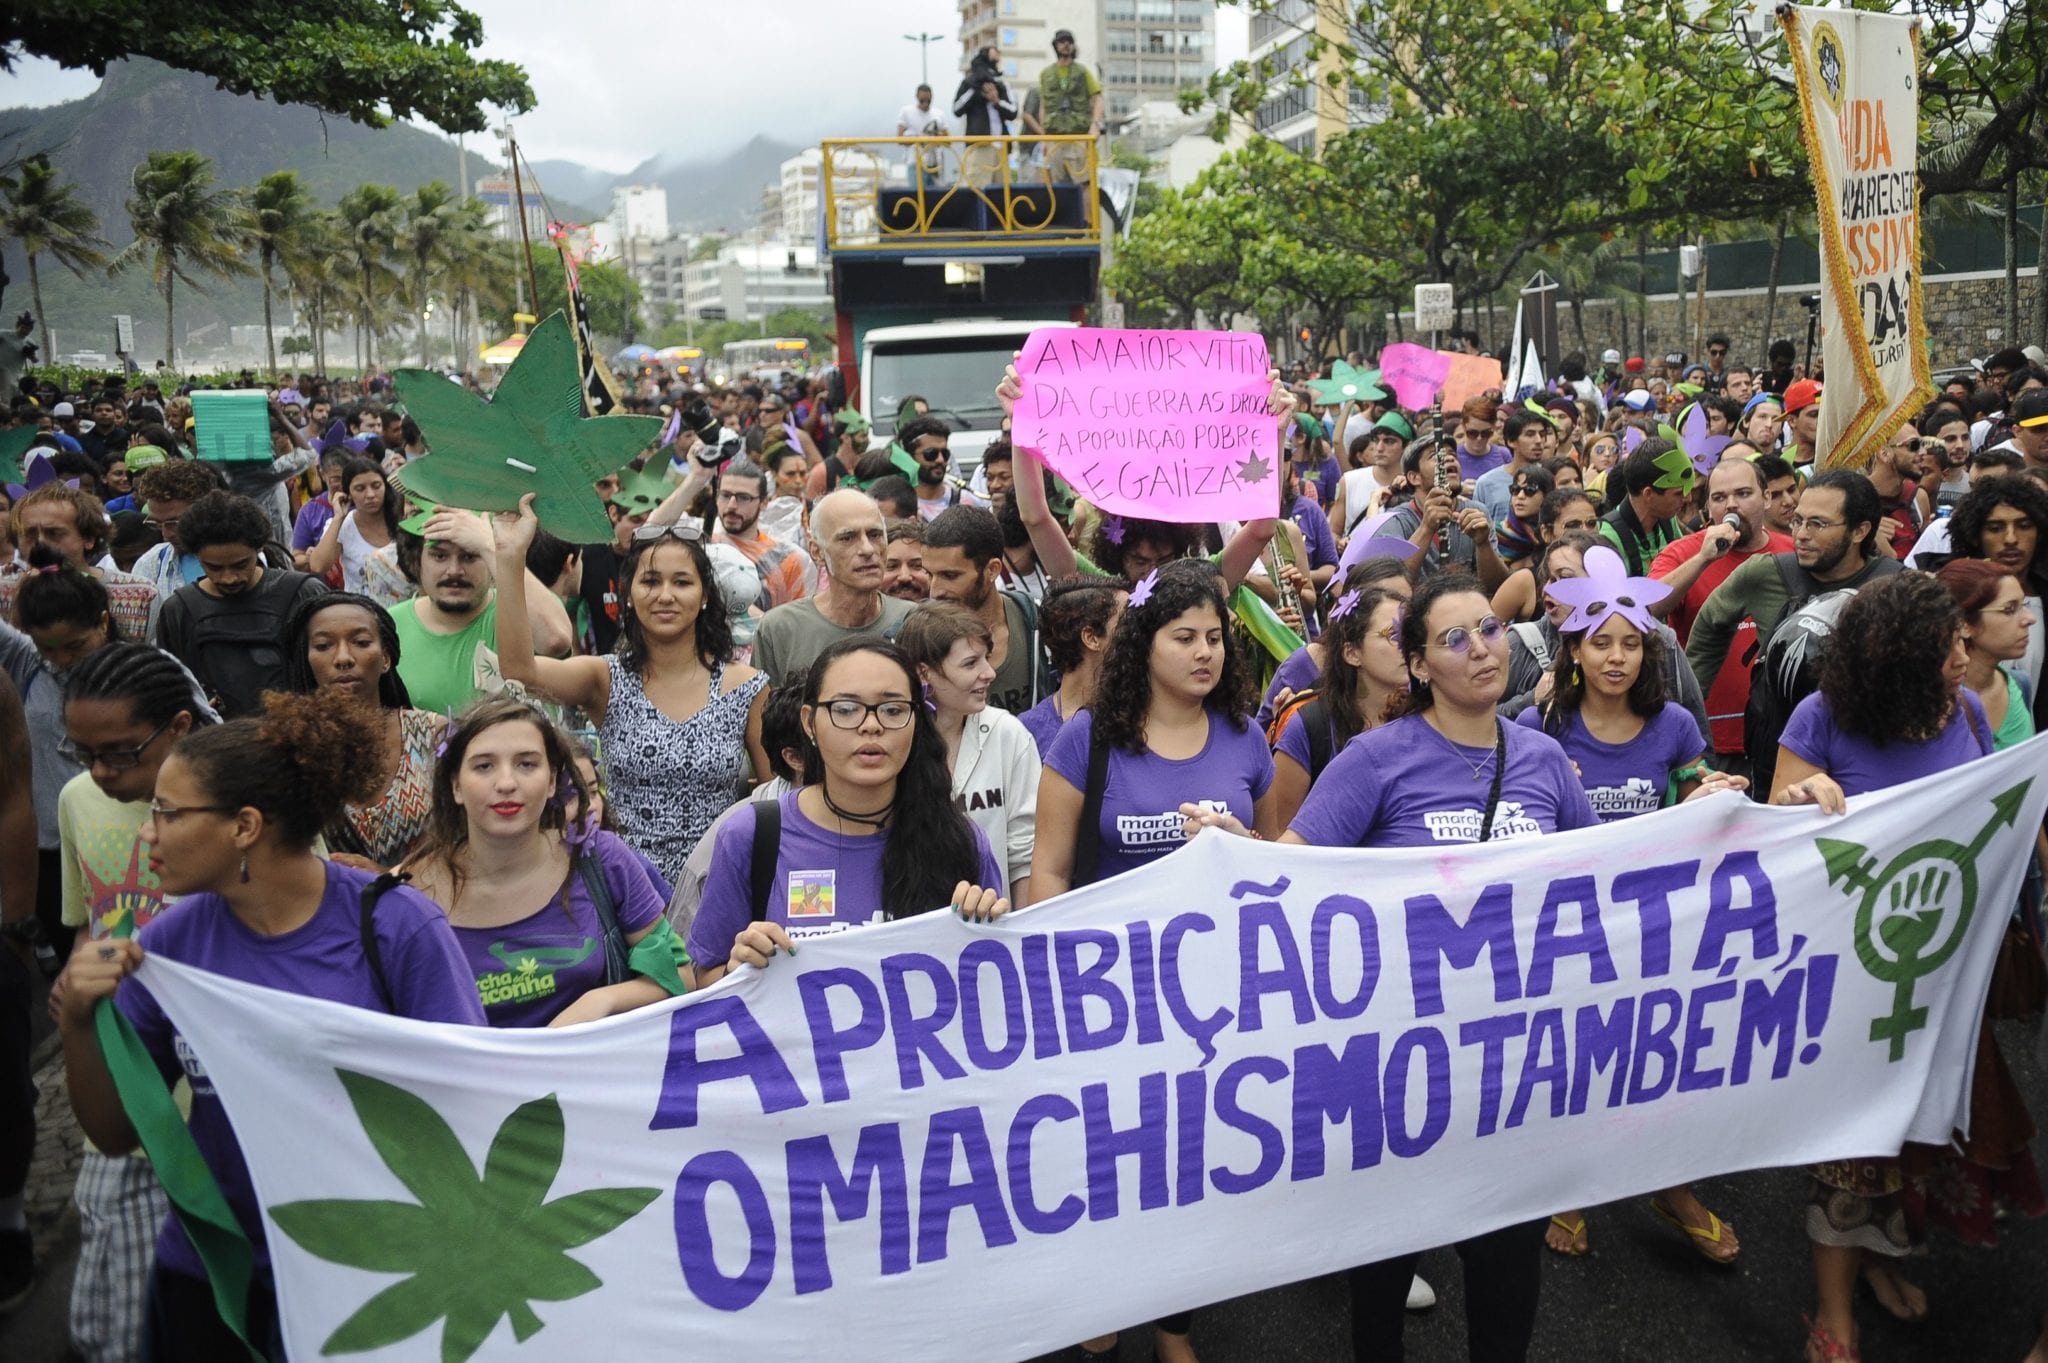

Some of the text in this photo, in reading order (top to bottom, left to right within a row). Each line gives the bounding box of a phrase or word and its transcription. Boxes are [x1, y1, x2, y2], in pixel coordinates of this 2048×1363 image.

[1034, 334, 1270, 375] A MAIOR VITIM
[1034, 383, 1080, 419] DA
[1089, 386, 1193, 419] GUERRA
[1198, 391, 1223, 413] AS
[1057, 432, 1073, 456] A
[1194, 424, 1262, 449] POBRE
[649, 850, 1808, 1131] A PROIBIÇÃO MATA,
[673, 954, 1840, 1312] O MACHISMO TAMBÉM!
